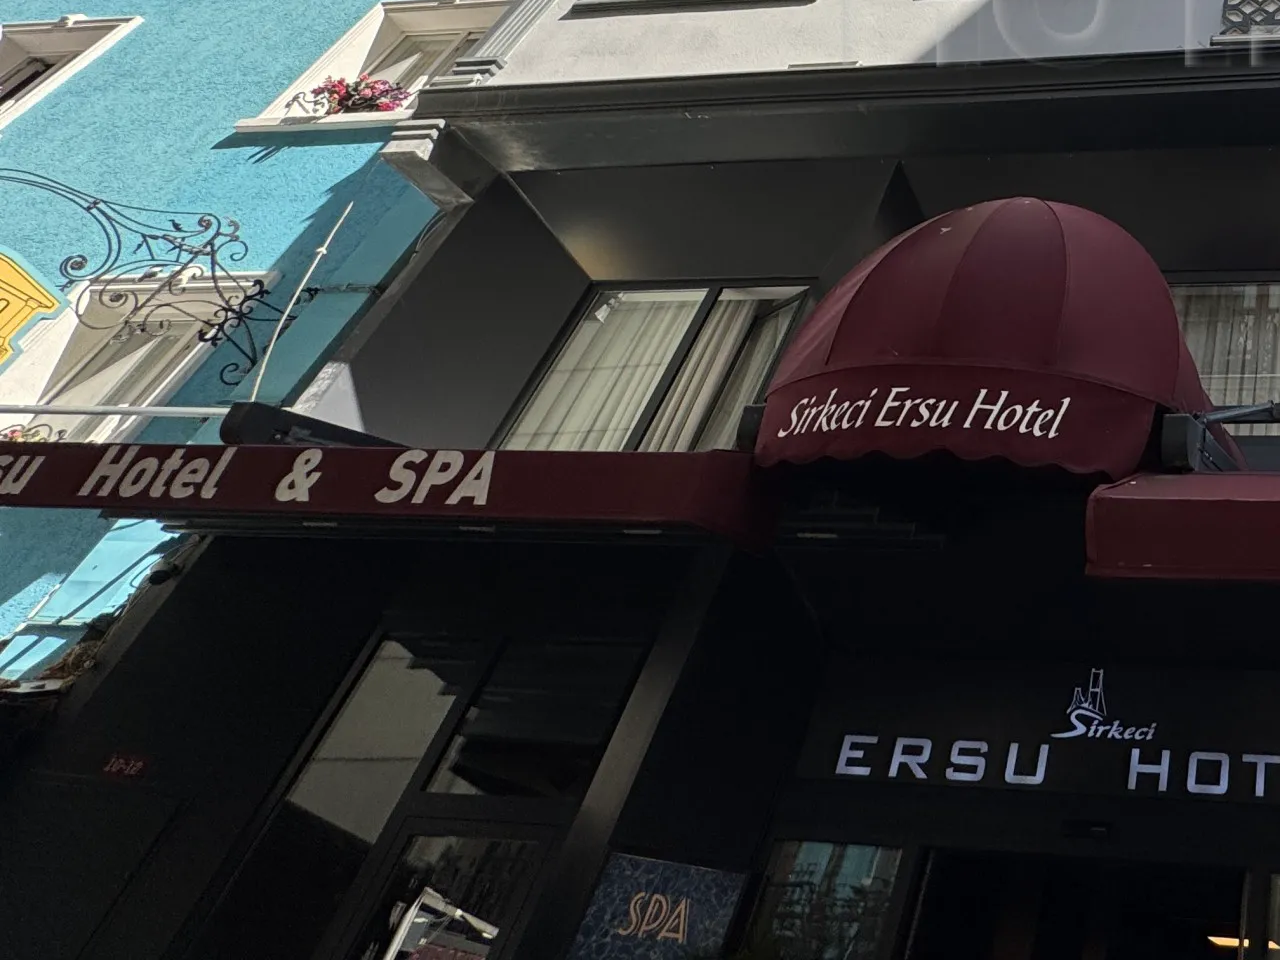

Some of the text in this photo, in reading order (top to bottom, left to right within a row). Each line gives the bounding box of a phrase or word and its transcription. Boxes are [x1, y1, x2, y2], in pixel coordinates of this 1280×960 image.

[778, 387, 1071, 439] Sirkeci Ersu Hotel
[77, 445, 238, 499] Hotel
[275, 448, 323, 502] &
[374, 449, 497, 505] SPA
[1050, 708, 1157, 741] Sirkeci
[835, 735, 1049, 785] ERSU
[617, 891, 691, 945] SPA
